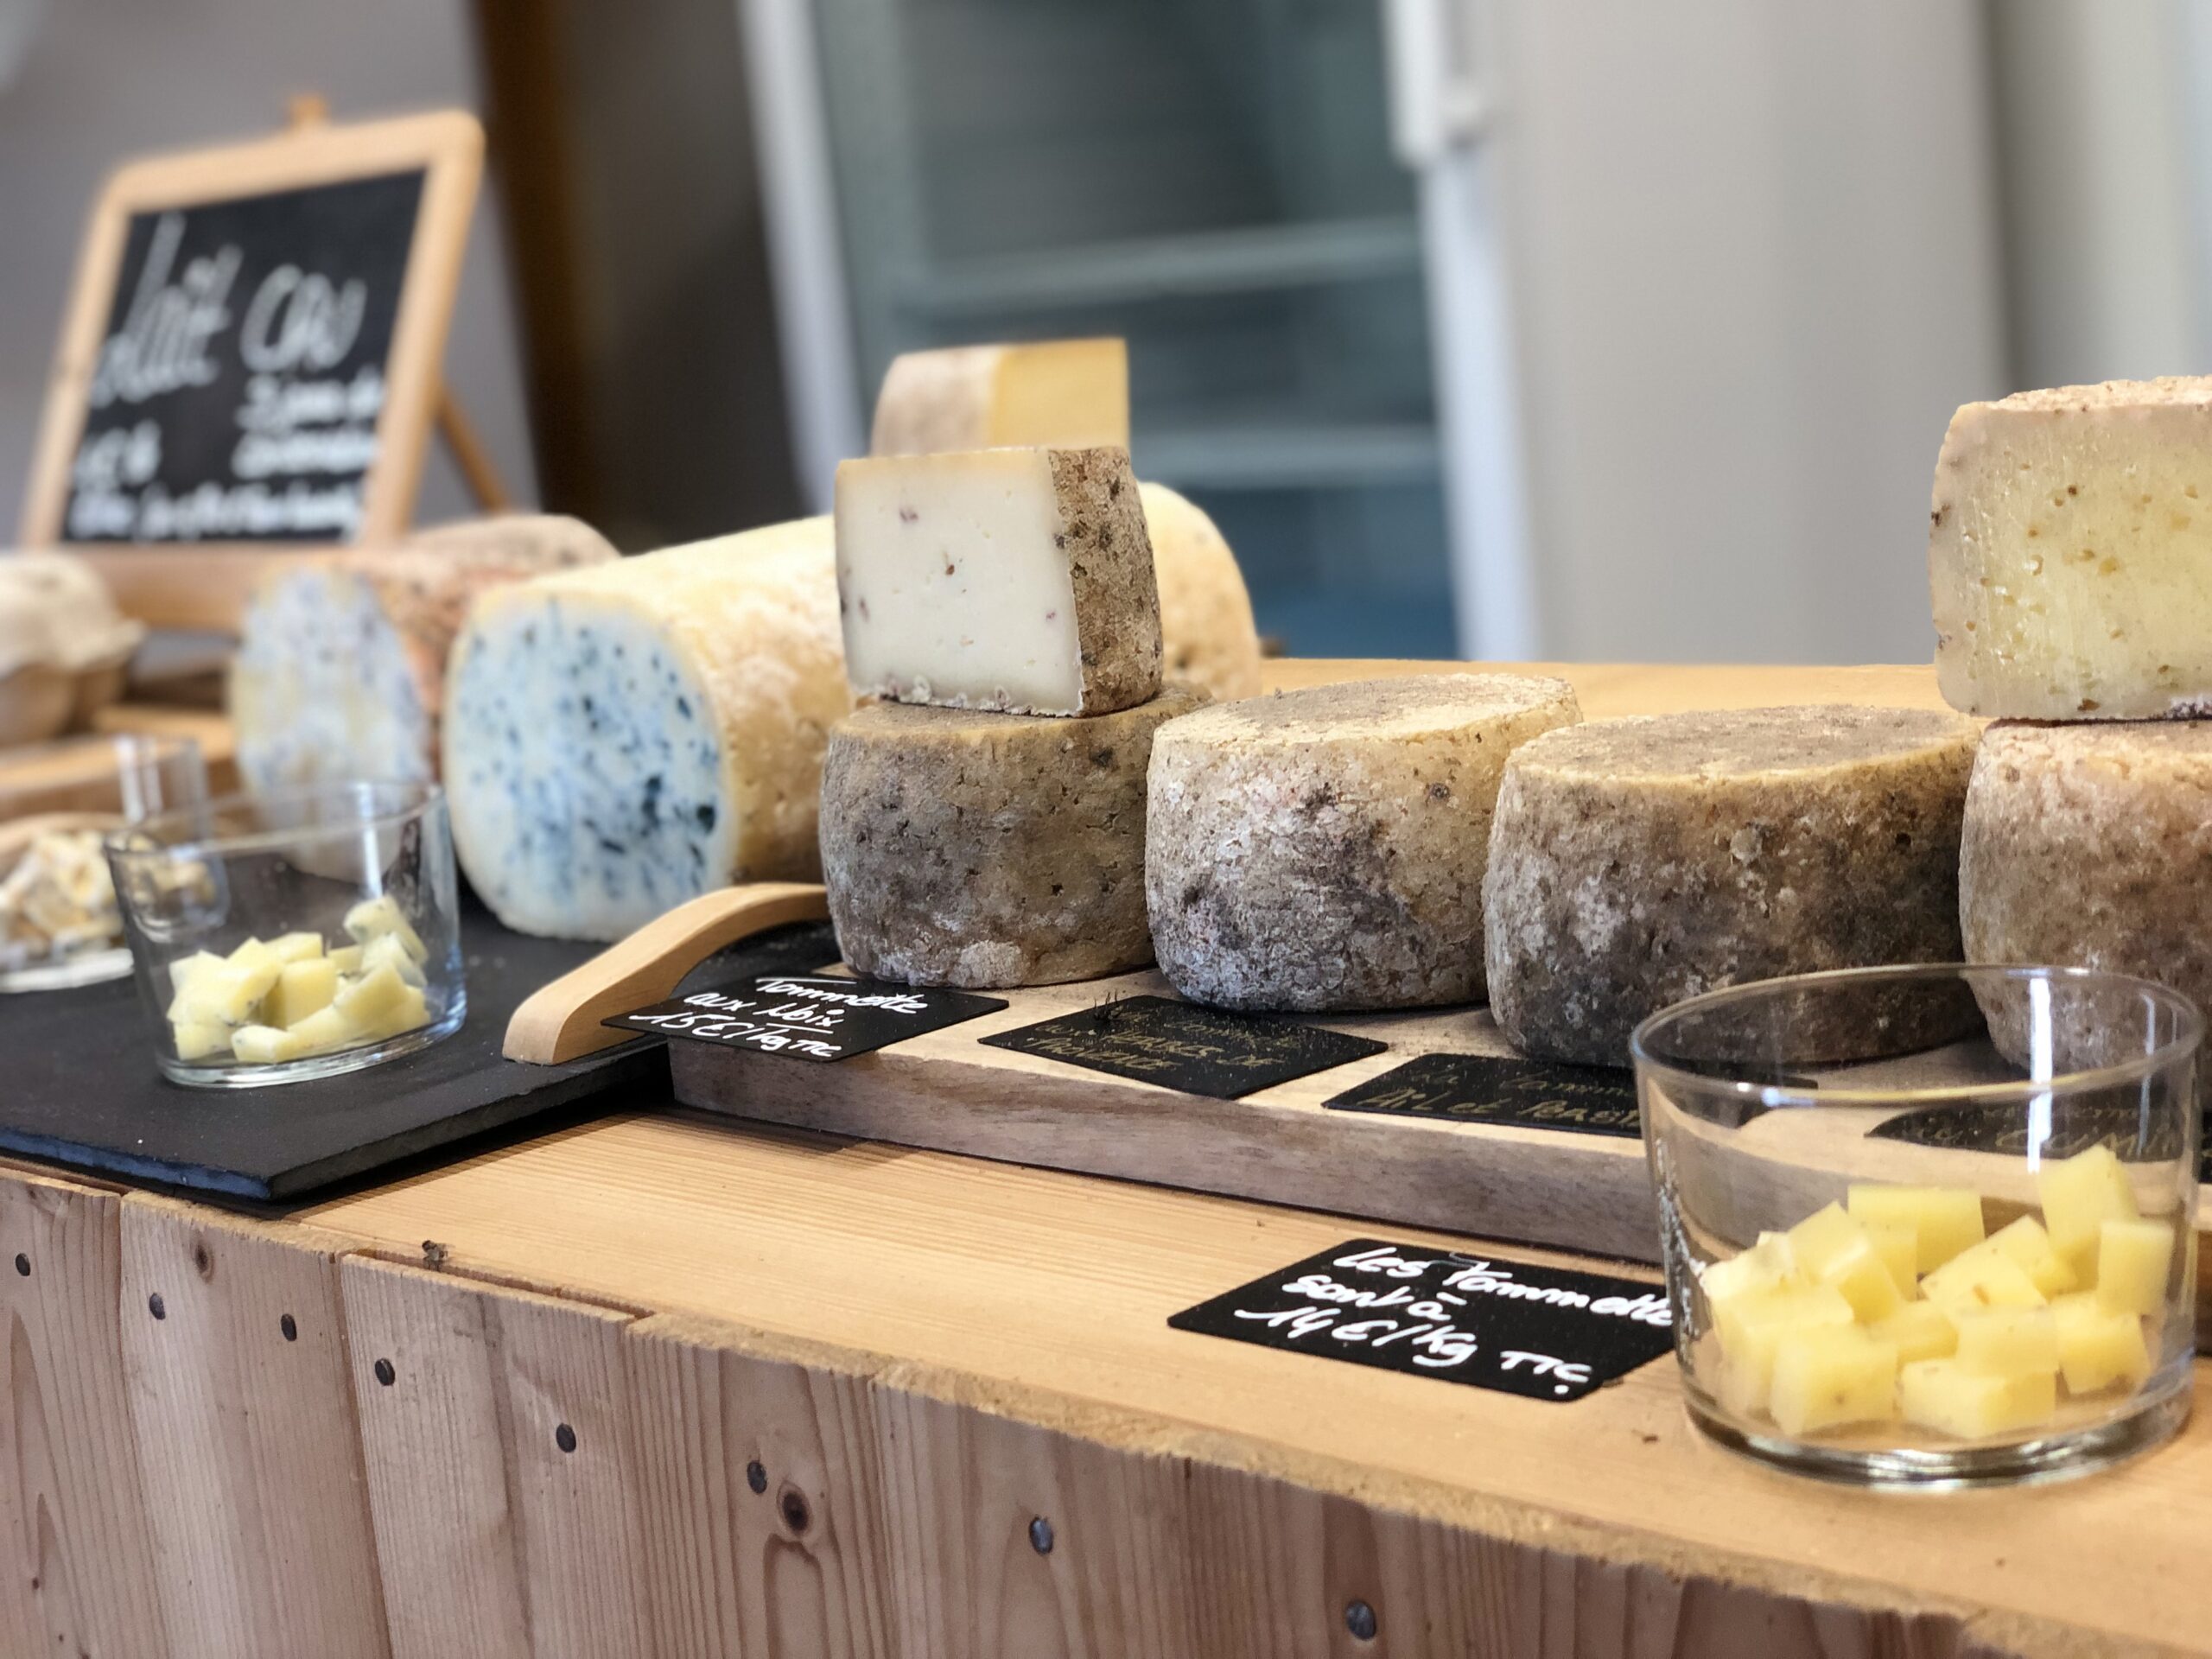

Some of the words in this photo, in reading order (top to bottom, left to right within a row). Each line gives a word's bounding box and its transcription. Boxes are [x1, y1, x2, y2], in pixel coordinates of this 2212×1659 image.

[683, 992, 756, 1013] aux
[753, 1002, 845, 1028] Noix
[755, 976, 930, 1014] Tommette
